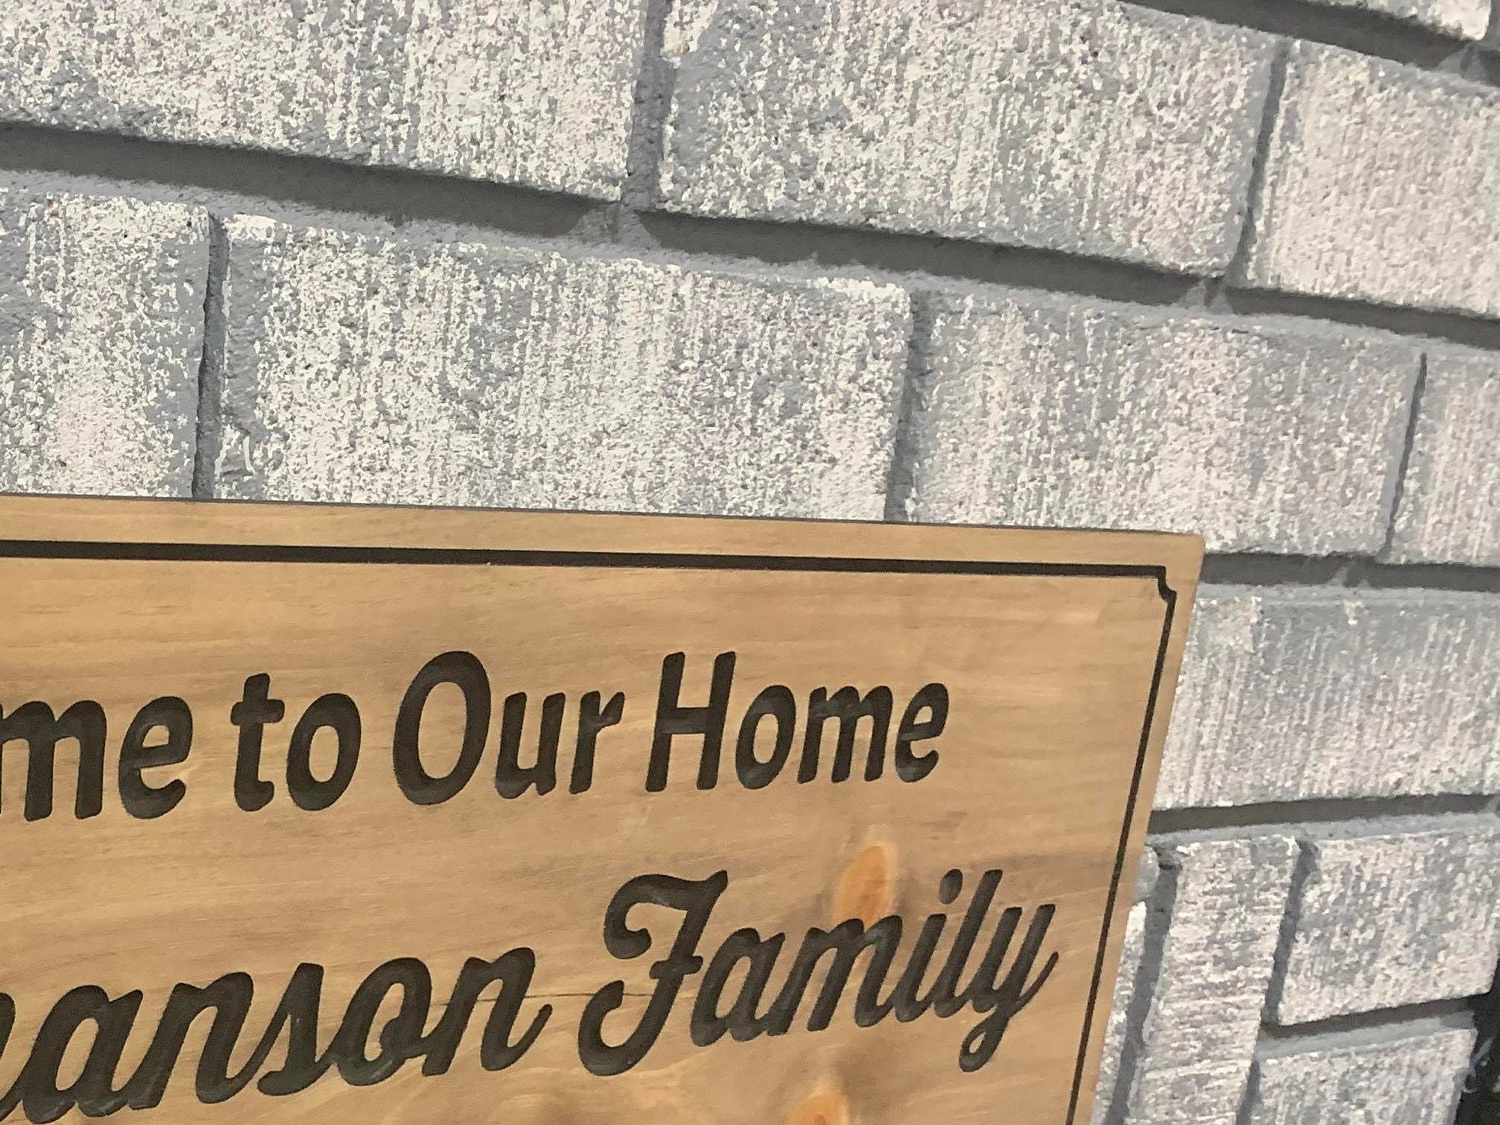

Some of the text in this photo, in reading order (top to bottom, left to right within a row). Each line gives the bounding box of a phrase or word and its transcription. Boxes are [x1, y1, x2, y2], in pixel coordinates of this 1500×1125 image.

[230, 672, 362, 812] to
[392, 650, 626, 806] Our
[645, 650, 950, 793] Home
[576, 868, 1059, 1077] Family
